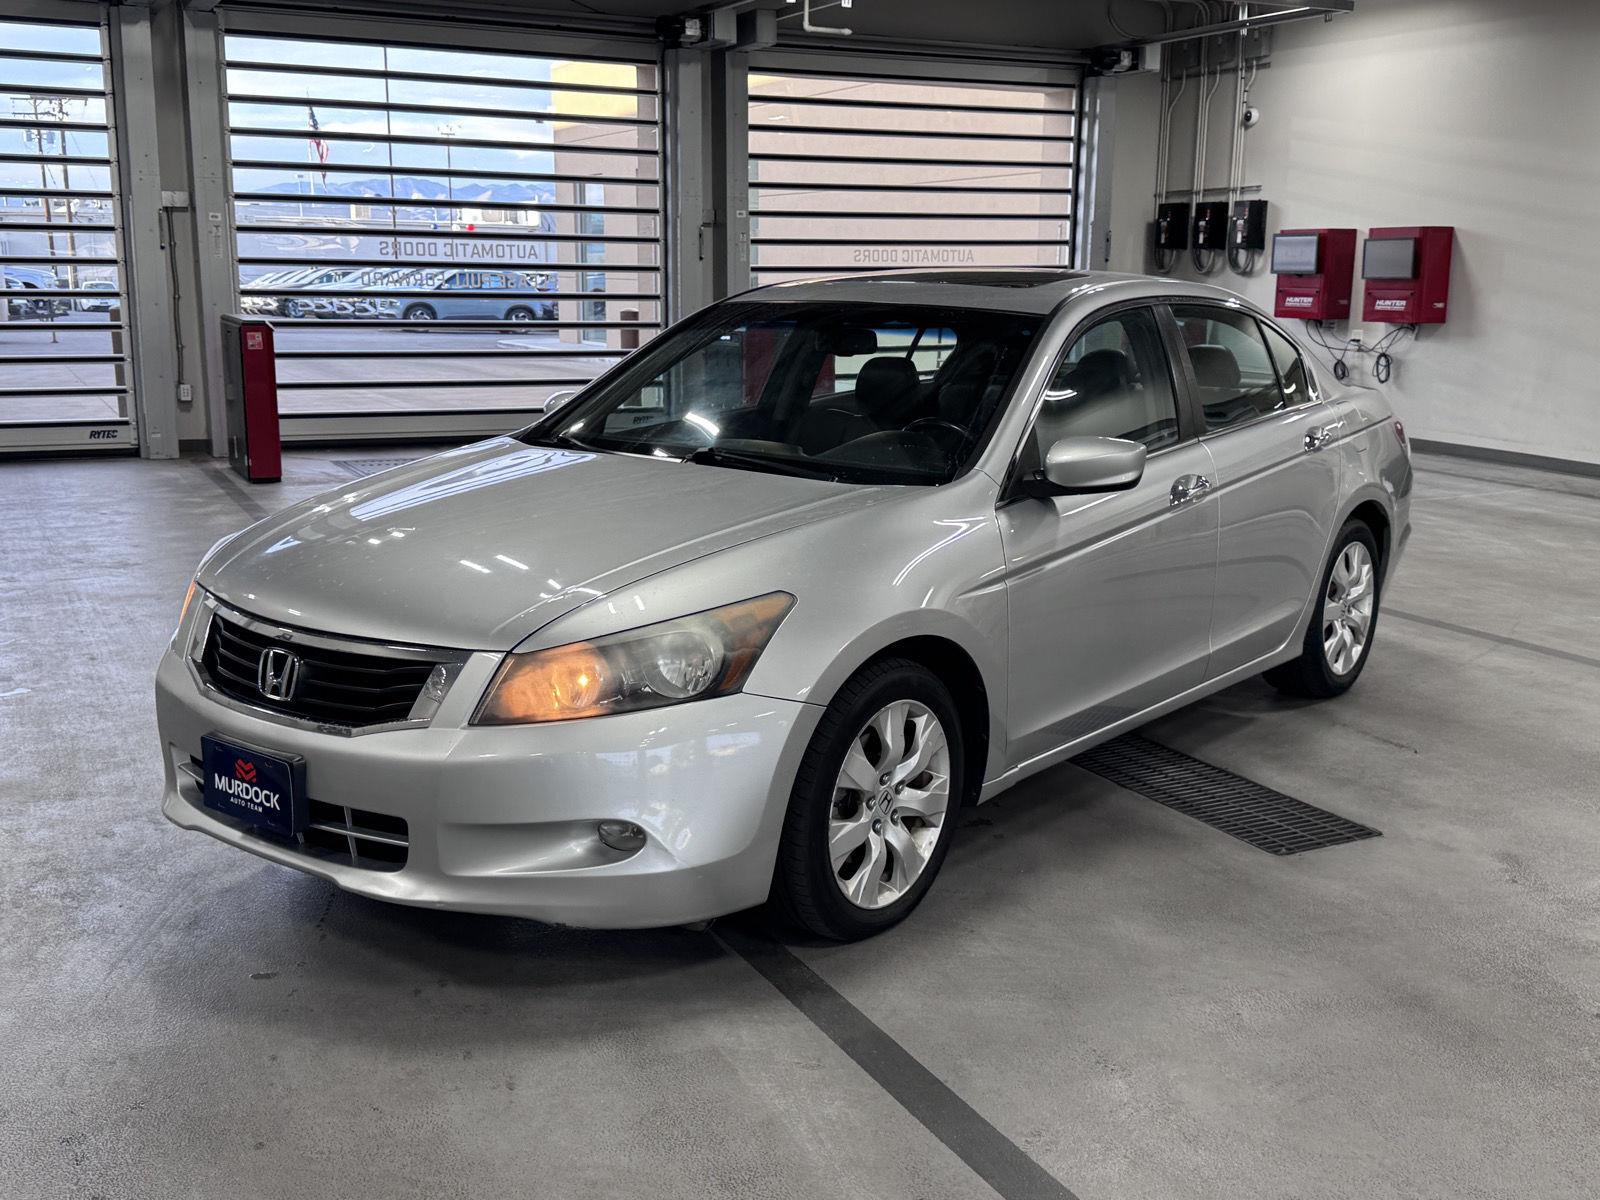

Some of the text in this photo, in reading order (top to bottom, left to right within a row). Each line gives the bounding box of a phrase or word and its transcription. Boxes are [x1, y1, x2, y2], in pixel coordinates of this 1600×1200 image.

[1285, 296, 1313, 304] HUNTER
[1375, 299, 1407, 307] HUNTER
[89, 429, 119, 440] RYTEC
[214, 772, 281, 811] MURDOCK
[230, 796, 263, 813] AUTO TEAM
